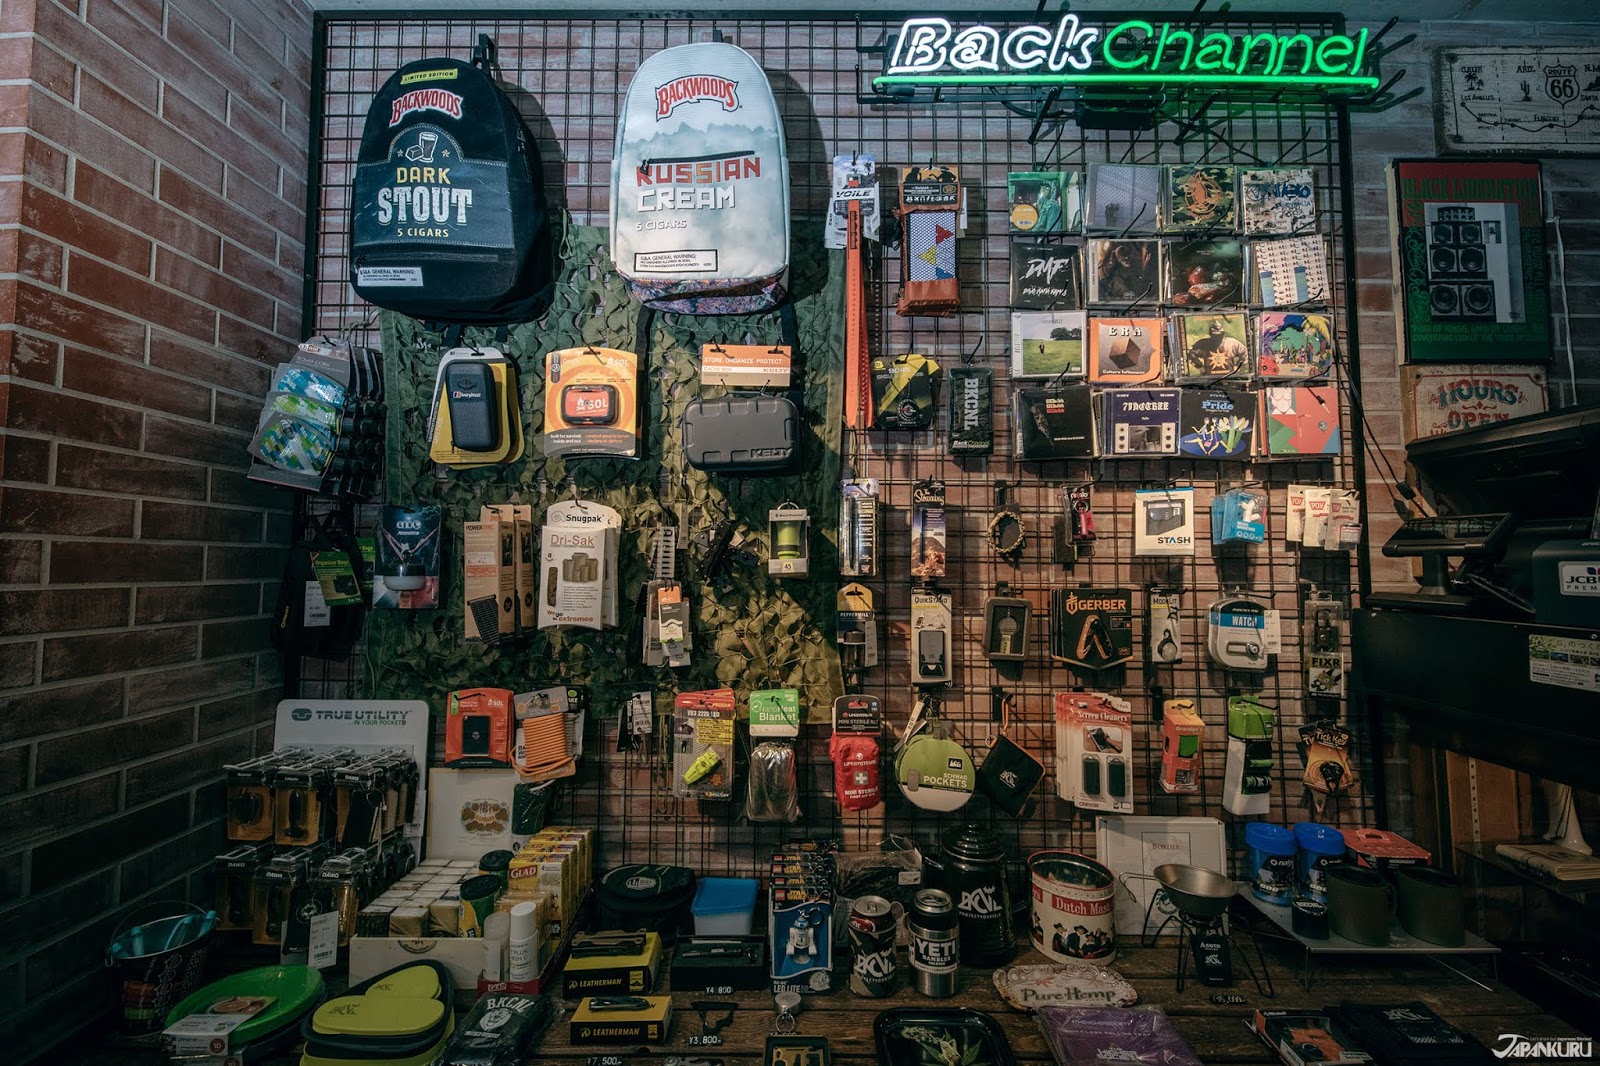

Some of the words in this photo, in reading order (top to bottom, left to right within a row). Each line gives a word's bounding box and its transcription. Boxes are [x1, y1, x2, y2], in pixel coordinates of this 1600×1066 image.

[887, 14, 1099, 75] Back
[1103, 20, 1368, 75] Channel
[404, 73, 426, 82] LIMITED
[428, 72, 454, 80] EDITION
[1550, 79, 1575, 98] 66
[655, 74, 739, 122] BACKWOODS
[389, 88, 463, 128] BACKWOODS
[396, 167, 451, 184] DARK
[636, 157, 761, 187] RUSSIAN
[1401, 178, 1449, 200] BLACK
[1452, 177, 1539, 200] LIBERATION
[637, 185, 736, 212] CREAM
[378, 186, 472, 225] STOUT
[636, 222, 642, 231] 5
[646, 220, 688, 230] CIGARS
[397, 229, 403, 237] 5
[407, 228, 449, 238] CIGARS
[1109, 326, 1142, 337] ERA
[1438, 379, 1519, 410] HOURS
[588, 398, 608, 410] SOL
[964, 378, 979, 431] BKCNL
[1202, 400, 1234, 411] Pride
[750, 448, 792, 460] KELTY
[566, 513, 602, 524] Snugpak
[550, 534, 594, 546] Dri-Sak
[1078, 600, 1127, 610] GERBER
[1312, 658, 1340, 667] FIXR
[316, 711, 352, 720] TRUE
[355, 711, 410, 720] UTILITY
[760, 713, 796, 721] Blanket
[1078, 710, 1098, 720] Screen
[1100, 712, 1128, 722] Cleaners
[1316, 730, 1331, 742] Tick
[1332, 734, 1347, 746] Key
[923, 775, 967, 788] POCKETS
[510, 867, 536, 879] GLAD
[1056, 897, 1087, 915] Dutch
[916, 937, 956, 957] YETI
[579, 978, 622, 988] LEATHERMAN
[786, 985, 801, 993] LITE
[1021, 987, 1063, 1002] Pure
[1066, 986, 1116, 1002] Hemp
[593, 1028, 640, 1036] LEATHERMAN
